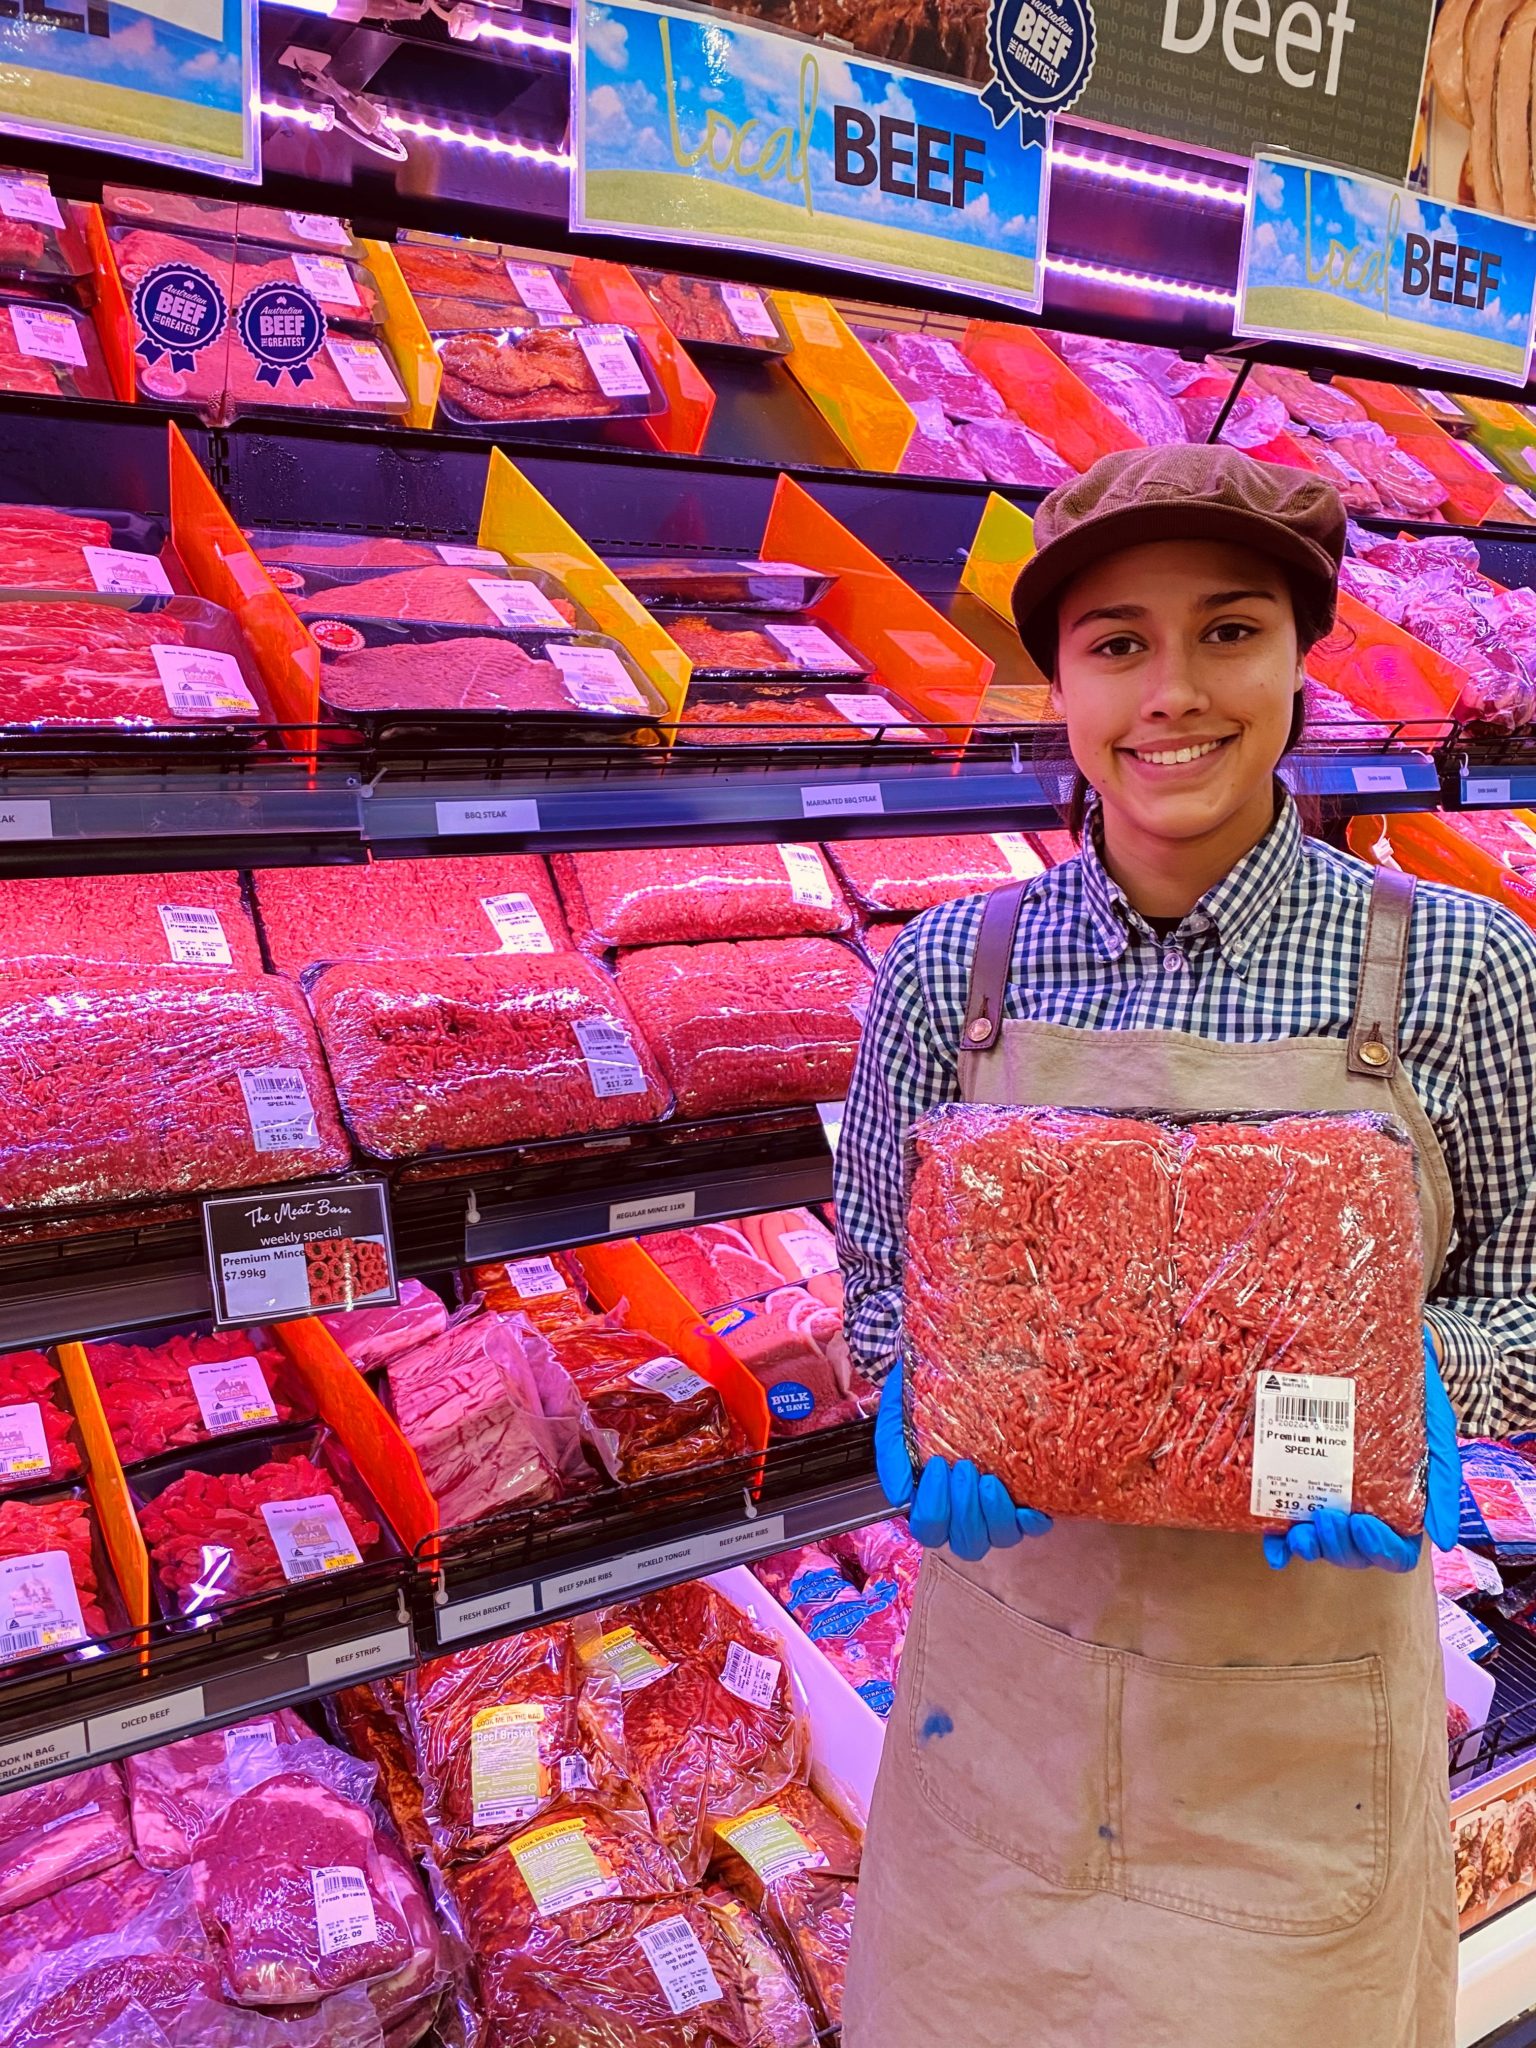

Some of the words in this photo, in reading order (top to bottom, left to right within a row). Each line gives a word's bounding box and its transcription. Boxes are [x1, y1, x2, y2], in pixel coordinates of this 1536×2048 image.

[1030, 0, 1074, 36] ustralian
[1013, 2, 1073, 69] BEEF
[1006, 37, 1018, 55] THE
[1014, 44, 1060, 88] GREATEST
[658, 16, 819, 216] Local
[833, 104, 986, 210] BEEF
[1304, 169, 1400, 322] Local
[1402, 232, 1502, 310] BEEF
[163, 284, 207, 305] Australian
[156, 291, 207, 325] BEEF
[260, 306, 303, 315] Australian
[153, 312, 162, 323] THE
[159, 316, 201, 337] GREATEST
[259, 315, 305, 336] BEEF
[260, 337, 268, 347] THE
[268, 337, 306, 347] GREATEST
[806, 798, 843, 807] MARINATED
[858, 795, 877, 803] STEAK
[0, 815, 16, 823] AK
[464, 811, 482, 819] BBQ
[483, 810, 507, 819] STEAK
[605, 1078, 634, 1089] $17.22
[270, 1133, 304, 1141] $16.90
[245, 1206, 272, 1228] The
[274, 1201, 315, 1224] Meat
[315, 1199, 353, 1216] Barn
[616, 1209, 646, 1220] REGULAR
[647, 1205, 668, 1214] MINCE
[260, 1231, 301, 1247] weekly
[303, 1226, 342, 1243] special
[223, 1254, 271, 1267] Premium
[273, 1249, 306, 1261] Mince
[224, 1268, 267, 1282] $7.99kg
[770, 1392, 810, 1406] BULK
[777, 1405, 785, 1414] &
[785, 1402, 811, 1412] SAVE
[1266, 1430, 1311, 1443] Premium
[1316, 1435, 1347, 1446] Mince
[1284, 1445, 1329, 1458] SPECIAL
[718, 1536, 735, 1547] BEEF
[734, 1531, 755, 1544] SPARE
[754, 1527, 769, 1539] RIBS
[637, 1556, 664, 1570] PICKELD
[664, 1548, 692, 1562] TONGUE
[557, 1582, 575, 1595] BEEF
[576, 1575, 597, 1589] SPARE
[597, 1571, 613, 1583] RIBS
[459, 1610, 482, 1623] FRESH
[482, 1601, 511, 1616] BRISKET
[821, 1606, 858, 1626] AUSTRALIAN
[836, 1623, 854, 1635] MEAT
[335, 1653, 354, 1665] BEEF
[355, 1645, 381, 1659] STRIPS
[608, 1641, 636, 1658] Brisket
[872, 1702, 890, 1712] MEAT
[120, 1715, 148, 1730] DICED
[149, 1708, 171, 1721] BEEF
[476, 1731, 498, 1742] Beef
[500, 1728, 534, 1740] Brisket
[22, 1751, 33, 1761] IN
[35, 1744, 56, 1757] BAG
[33, 1750, 70, 1769] BRISKET
[729, 1827, 749, 1840] Beef
[749, 1815, 779, 1830] Brisket
[520, 1846, 543, 1860] Beef
[545, 1833, 579, 1850] Brisket
[322, 1895, 340, 1904] Fresh
[342, 1891, 366, 1899] Brisket
[333, 1929, 362, 1944] $22.09
[658, 1951, 673, 1960] Cook
[684, 1942, 694, 1950] the
[677, 1950, 698, 1960] Korean
[671, 1958, 696, 1972] Brisket
[681, 1984, 708, 2000] $30.92
